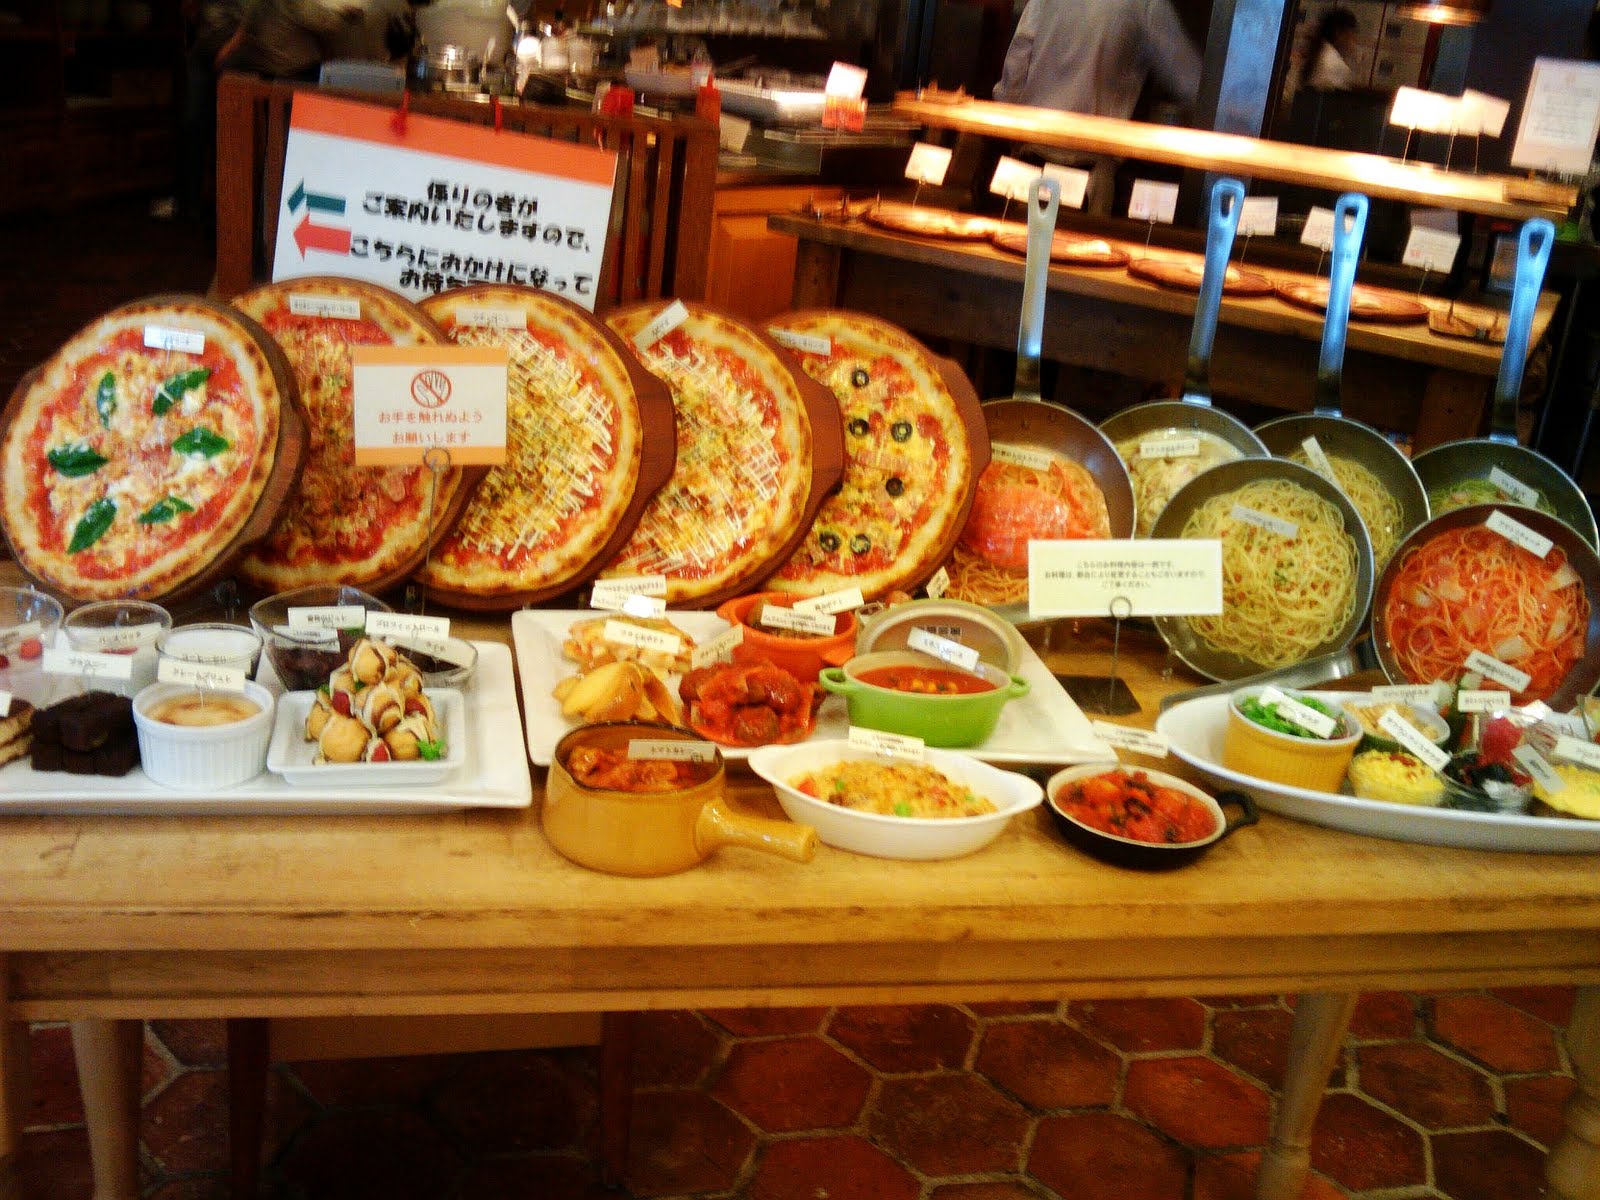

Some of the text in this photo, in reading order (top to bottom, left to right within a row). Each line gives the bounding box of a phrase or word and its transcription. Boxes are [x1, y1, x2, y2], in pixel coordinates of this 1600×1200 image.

[426, 178, 538, 219] 係りの者が
[363, 189, 591, 253] ご案内いたしますので、
[351, 235, 593, 295] こちらにおかけになって
[378, 410, 482, 424] お手を触れぬよう
[392, 431, 471, 444] お願いします
